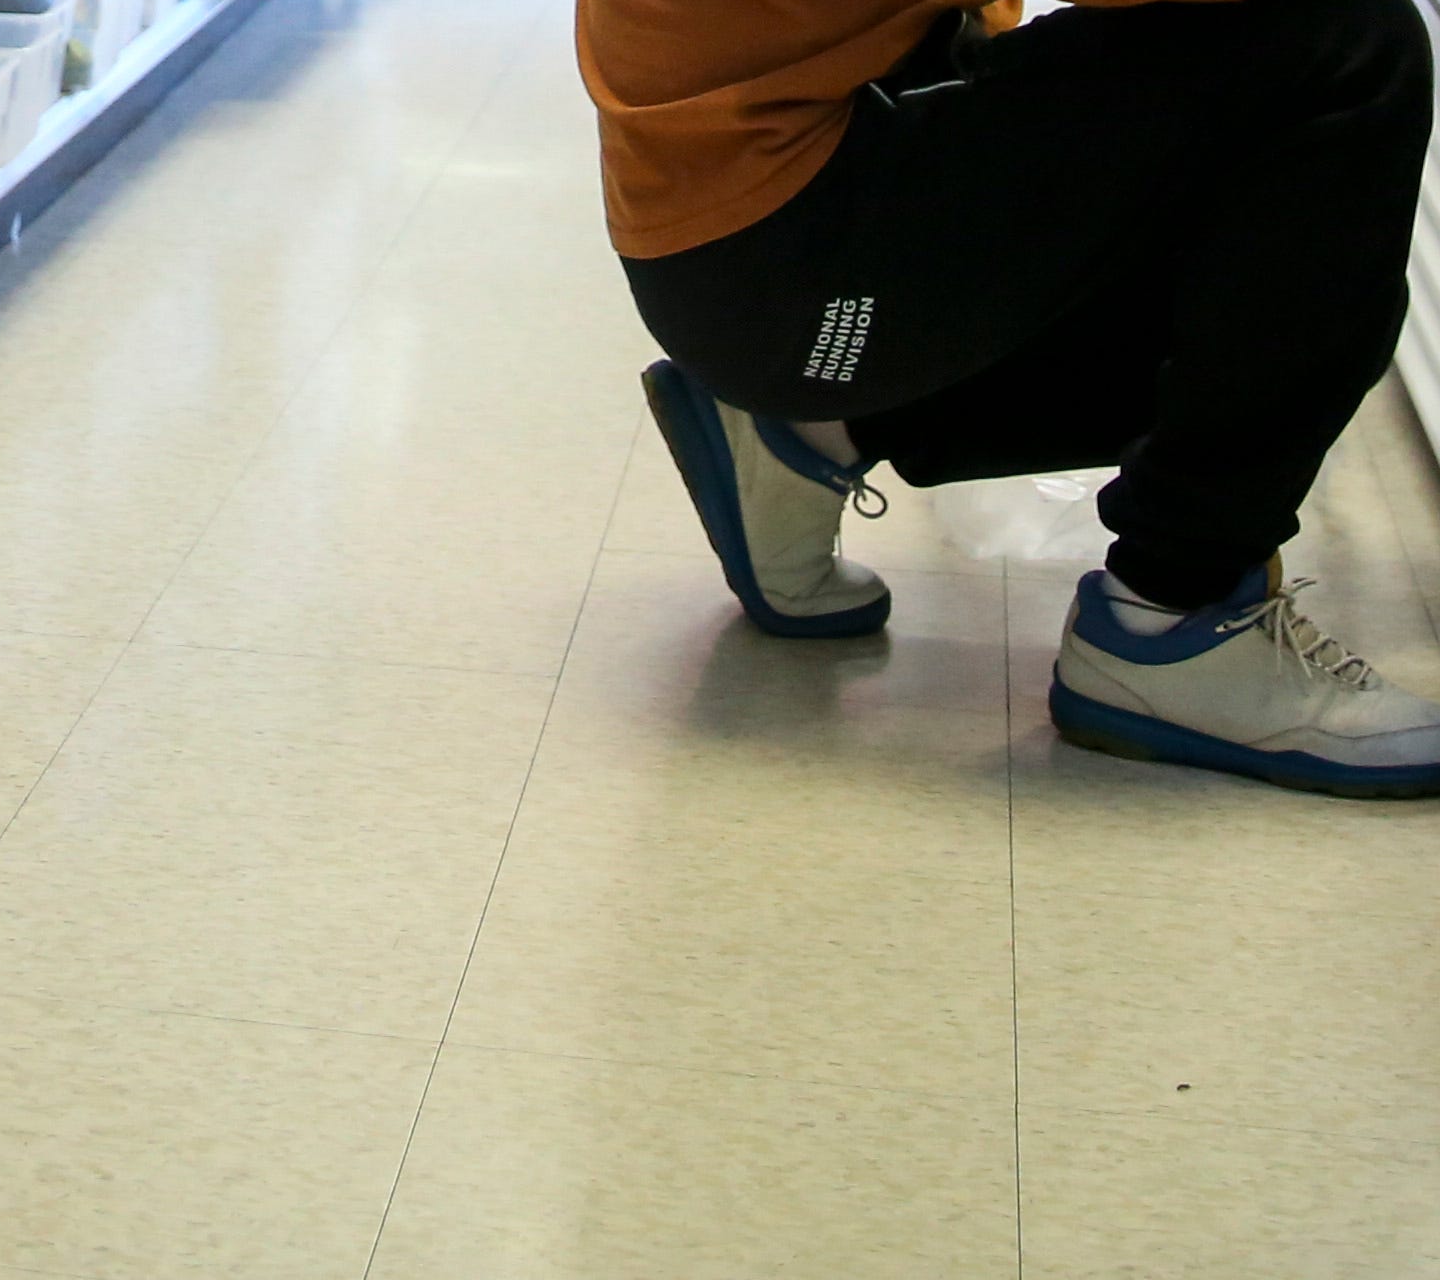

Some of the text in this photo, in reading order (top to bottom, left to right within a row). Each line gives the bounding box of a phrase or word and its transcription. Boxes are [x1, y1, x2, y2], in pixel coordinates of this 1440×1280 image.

[803, 297, 841, 379] NATIONAL
[821, 298, 857, 381] RUNNING
[838, 296, 875, 383] DIVISION
